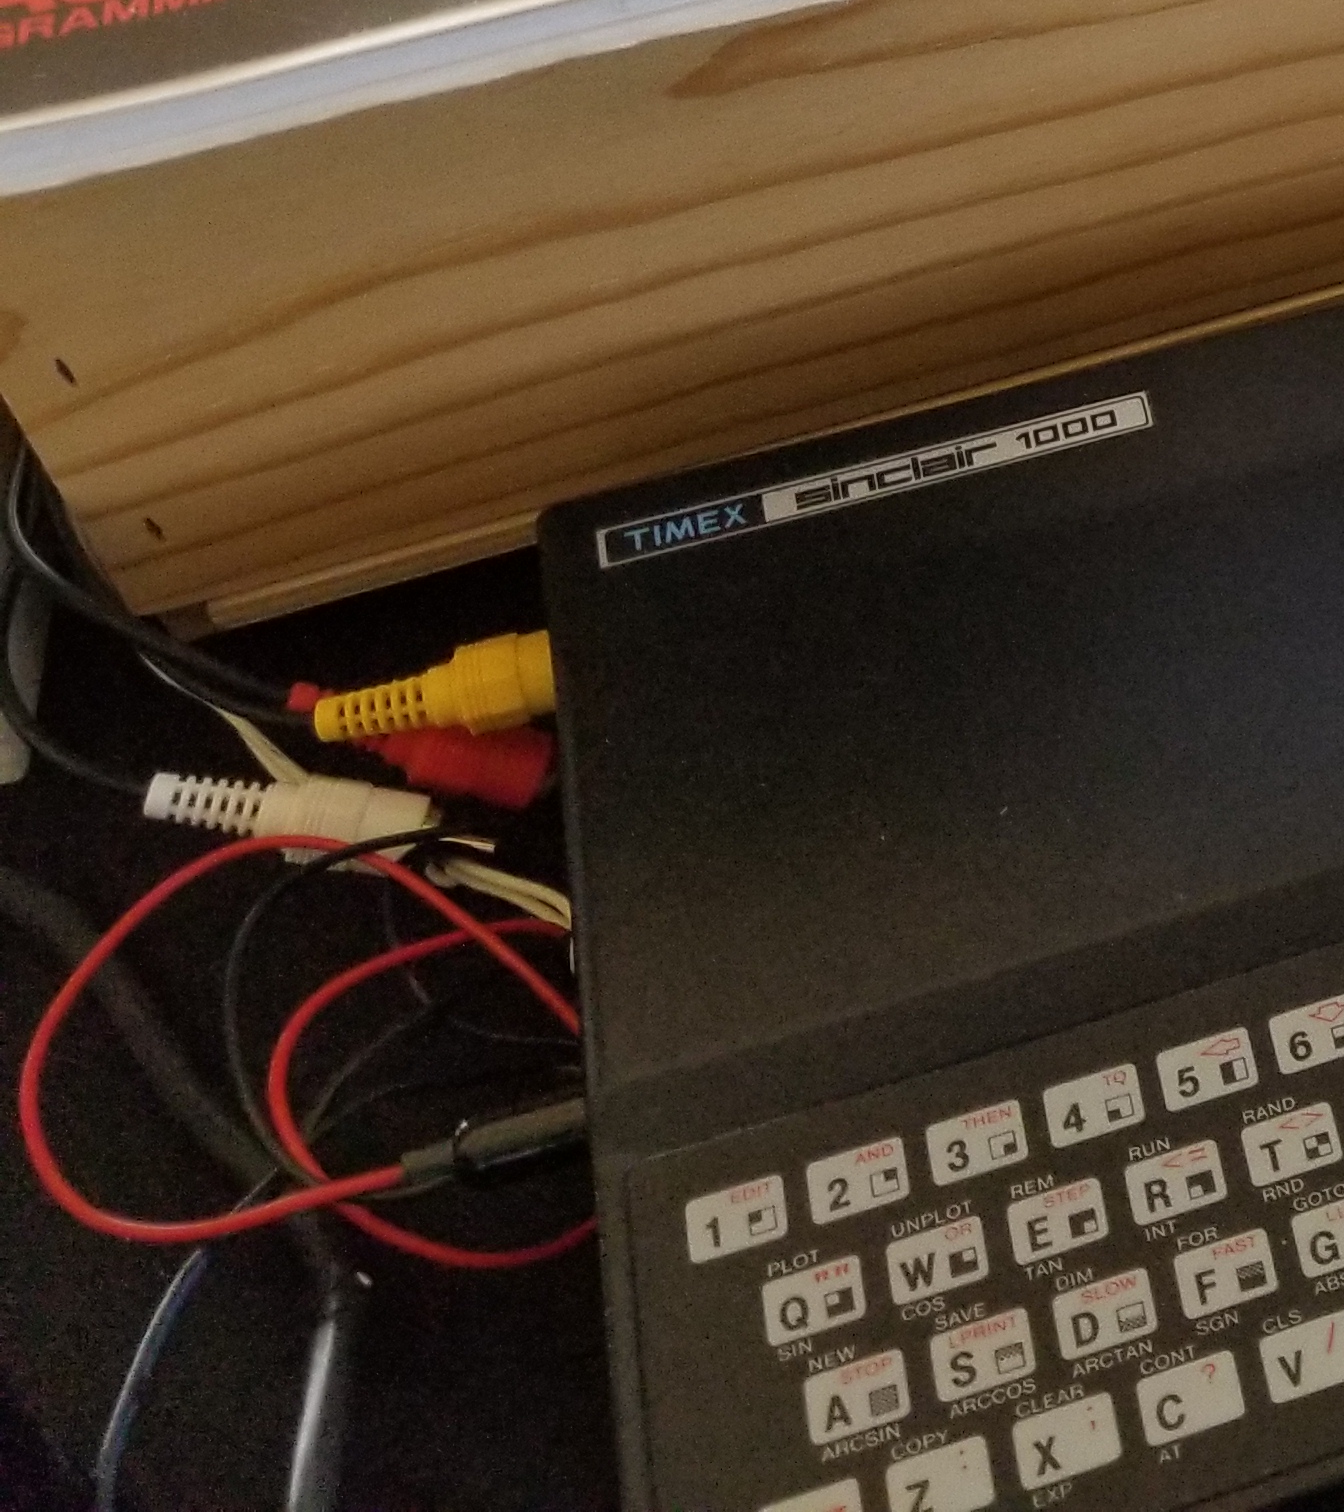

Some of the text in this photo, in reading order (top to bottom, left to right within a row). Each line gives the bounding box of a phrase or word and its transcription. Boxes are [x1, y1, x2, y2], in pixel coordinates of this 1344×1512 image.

[624, 409, 1116, 550] TIMEX sinclair 1000
[1178, 1068, 1200, 1097] 5
[1063, 1104, 1086, 1133] 4
[946, 1141, 969, 1172] 3
[891, 1200, 971, 1238] UNPLOT
[1072, 1341, 1154, 1378] ARCTAN
